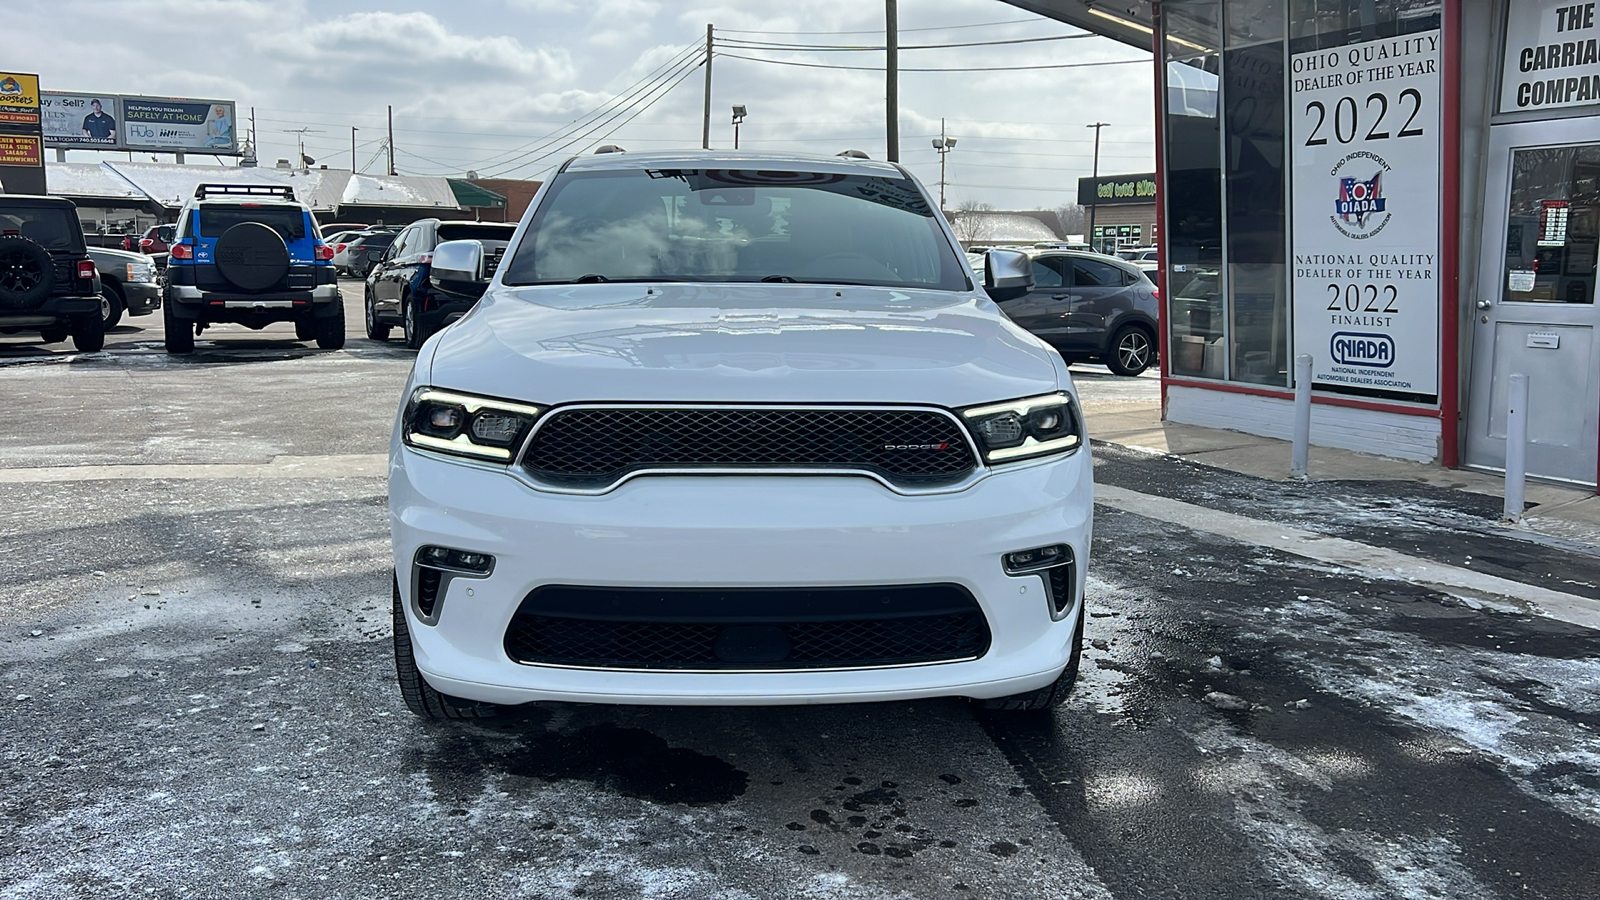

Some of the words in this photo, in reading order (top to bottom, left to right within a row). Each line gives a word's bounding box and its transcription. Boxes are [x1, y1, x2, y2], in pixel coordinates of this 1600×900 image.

[1556, 3, 1594, 32] THE
[1293, 53, 1338, 73] OHIO
[1349, 35, 1438, 66] QUALITY
[1520, 39, 1600, 72] CARRIA
[1295, 74, 1343, 92] DEALER
[1347, 71, 1363, 84] OF
[1367, 66, 1393, 82] THE
[1398, 59, 1435, 77] YEAR
[63, 99, 85, 107] Sell?
[1305, 88, 1423, 146] 2022
[130, 125, 154, 137] Hub
[1331, 159, 1345, 176] OHIO
[1346, 151, 1391, 172] INDEPENDENT
[1342, 200, 1377, 212] OIADA
[1296, 255, 1363, 264] NATIONAL
[1370, 255, 1434, 266] QUALITY
[1297, 269, 1341, 278] DEALER
[1347, 269, 1362, 278] OF
[1368, 269, 1392, 279] THE
[1398, 270, 1432, 279] YEAR
[1327, 284, 1398, 313] 2022
[1332, 315, 1392, 326] FINALIST
[1336, 339, 1388, 360] NIADA
[1317, 374, 1349, 382] AUTOMOBILE
[1374, 379, 1411, 388] ASSOCIATION
[1358, 368, 1395, 378] INDEPENDENT
